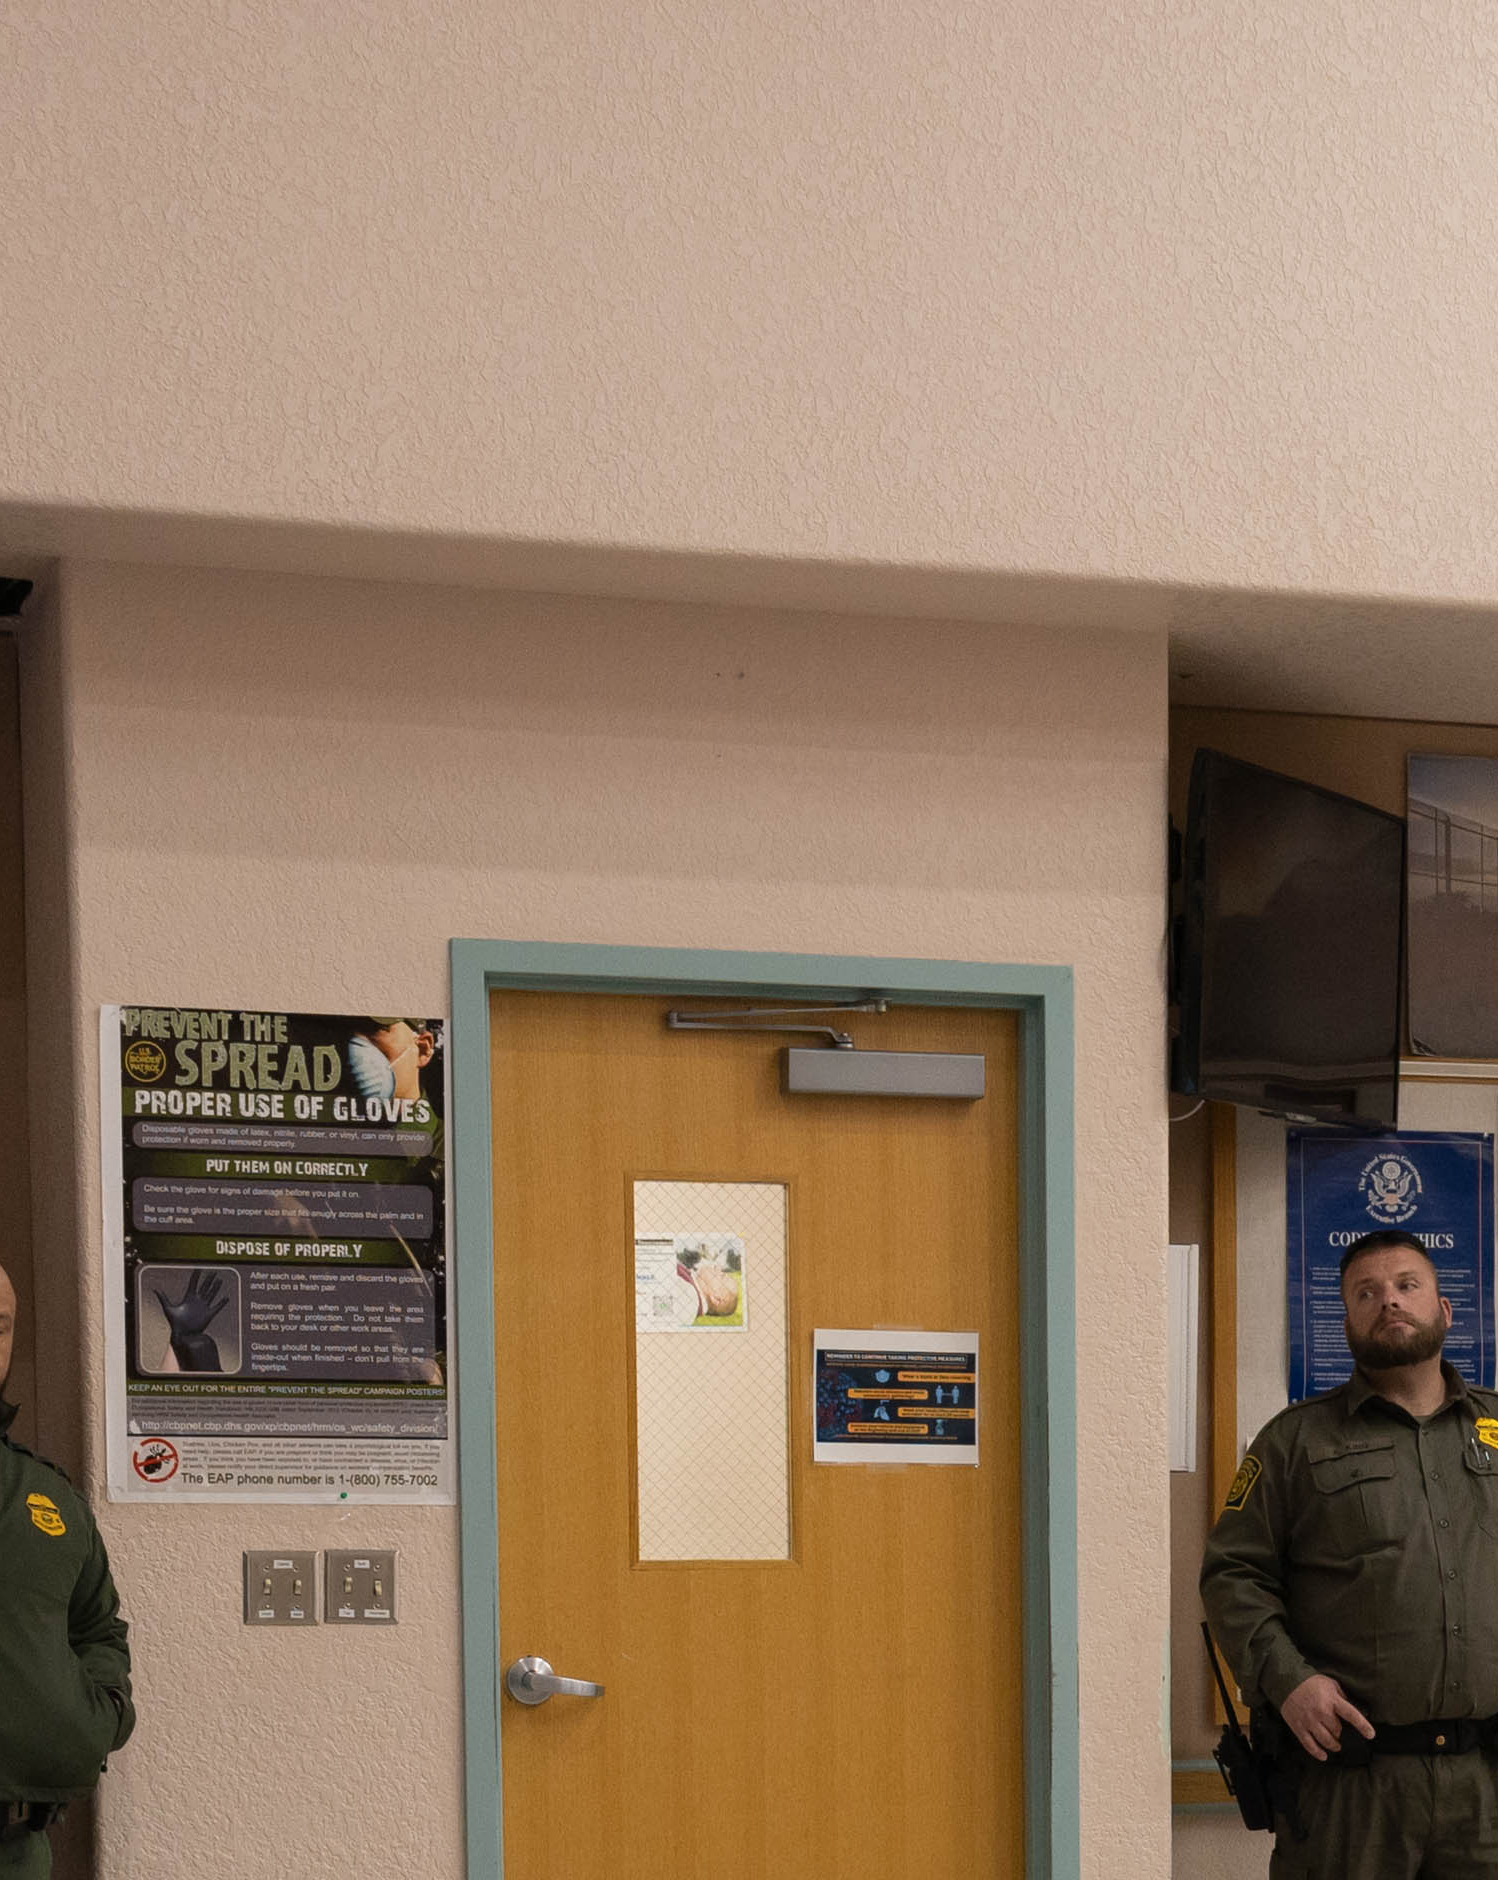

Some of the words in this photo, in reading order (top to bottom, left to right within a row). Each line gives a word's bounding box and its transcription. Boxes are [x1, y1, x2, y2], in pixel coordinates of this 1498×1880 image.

[122, 1008, 232, 1040] PREVENT
[240, 1012, 288, 1042] THE
[174, 1040, 342, 1091] SPREAD
[134, 1090, 233, 1117] PROPER
[238, 1092, 284, 1118] USE
[294, 1094, 324, 1120] OF
[333, 1096, 431, 1123] GLOVES
[206, 1159, 231, 1172] PUT
[234, 1160, 270, 1174] THEM
[274, 1161, 292, 1175] ON
[295, 1161, 369, 1177] CORRECTLY
[144, 1184, 169, 1193] Check
[171, 1184, 183, 1193] the
[185, 1185, 206, 1196] glove
[208, 1186, 219, 1194] for
[220, 1187, 241, 1196] signs
[243, 1186, 251, 1195] of
[312, 1190, 327, 1199] you
[328, 1190, 340, 1199] put
[216, 1240, 270, 1256] DISPOSE
[274, 1242, 291, 1256] OF
[295, 1243, 363, 1259] PROPERLY
[151, 1384, 163, 1392] AN
[164, 1384, 181, 1392] EYE
[202, 1385, 218, 1393] FOR
[220, 1385, 236, 1393] THE
[364, 1387, 404, 1396] CAMPAIGN
[181, 1473, 203, 1484] The
[208, 1473, 234, 1485] EAP
[237, 1474, 274, 1486] phone
[277, 1474, 322, 1486] number
[325, 1474, 335, 1485] is
[339, 1474, 381, 1488] 1-(800)
[384, 1475, 438, 1486] 755-7002
